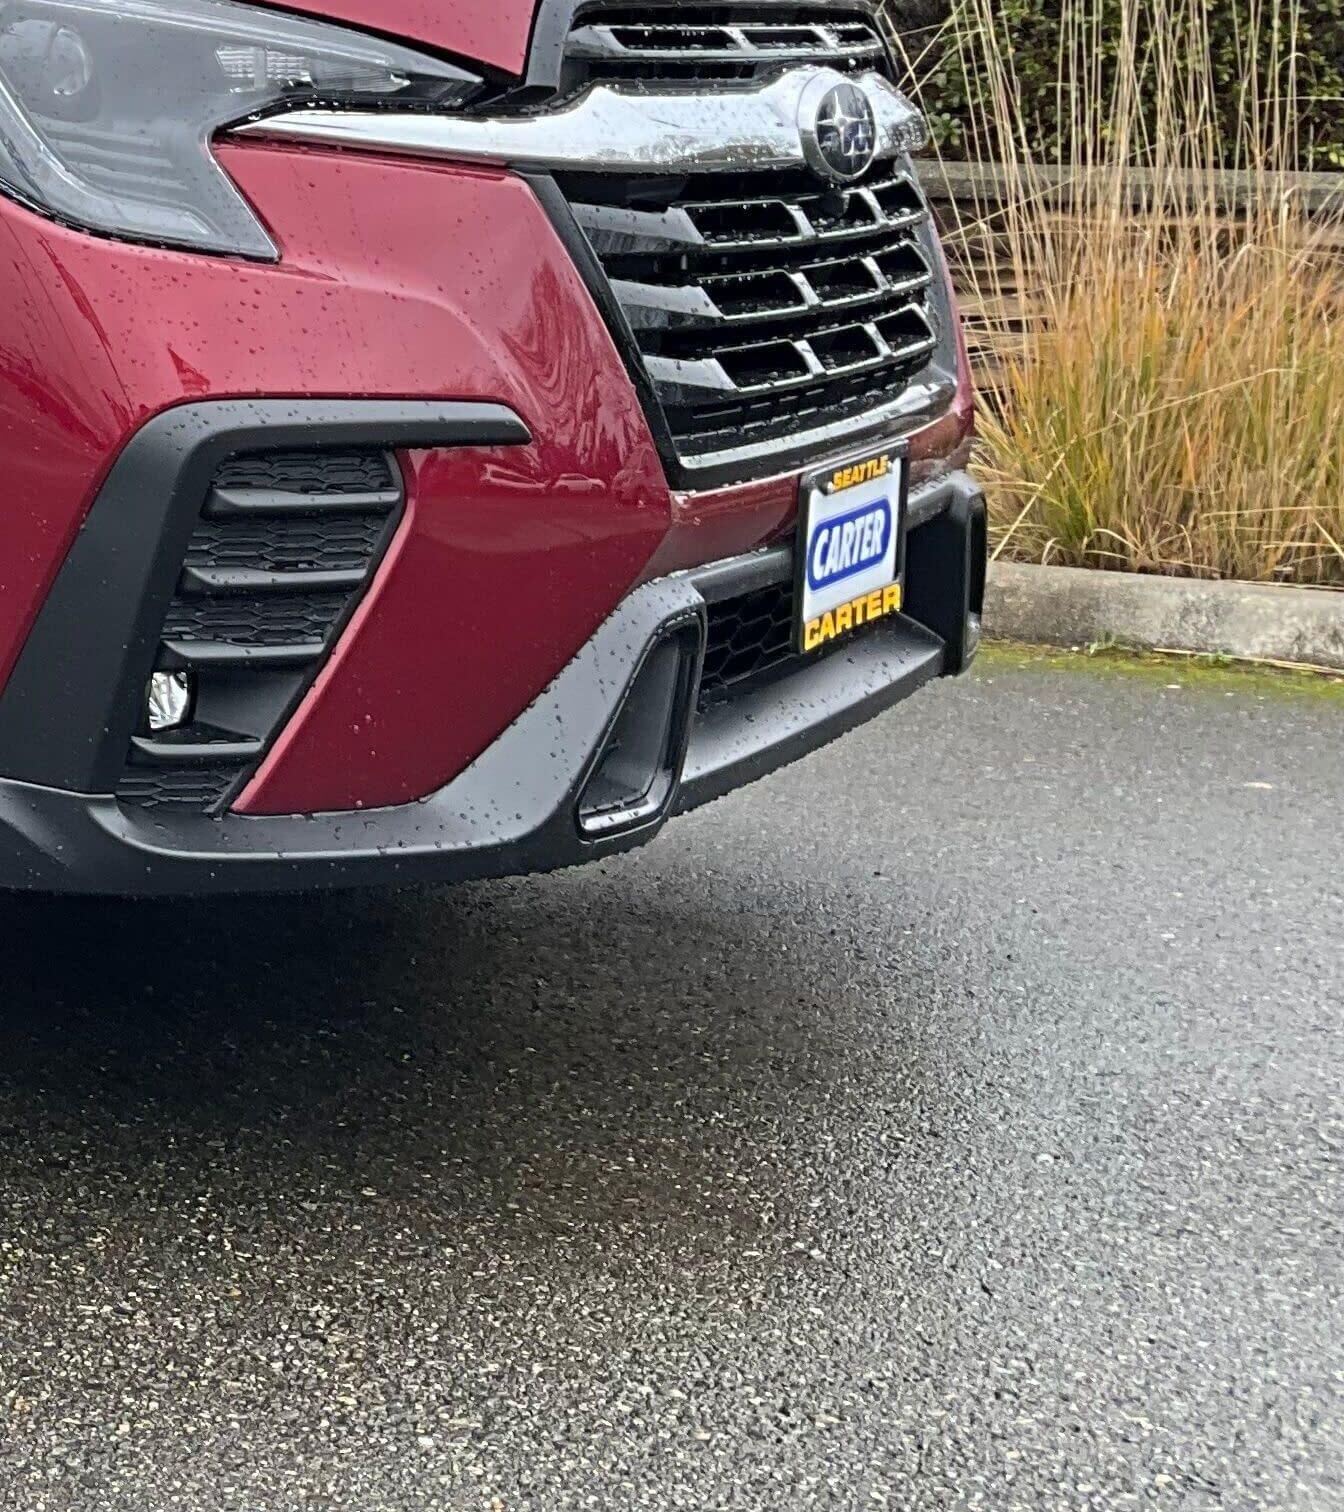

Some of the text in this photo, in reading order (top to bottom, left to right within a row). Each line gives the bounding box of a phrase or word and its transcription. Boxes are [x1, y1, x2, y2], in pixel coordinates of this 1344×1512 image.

[831, 455, 889, 492] SEATTLE
[813, 508, 886, 580] CARTER
[803, 583, 902, 651] CARTER
